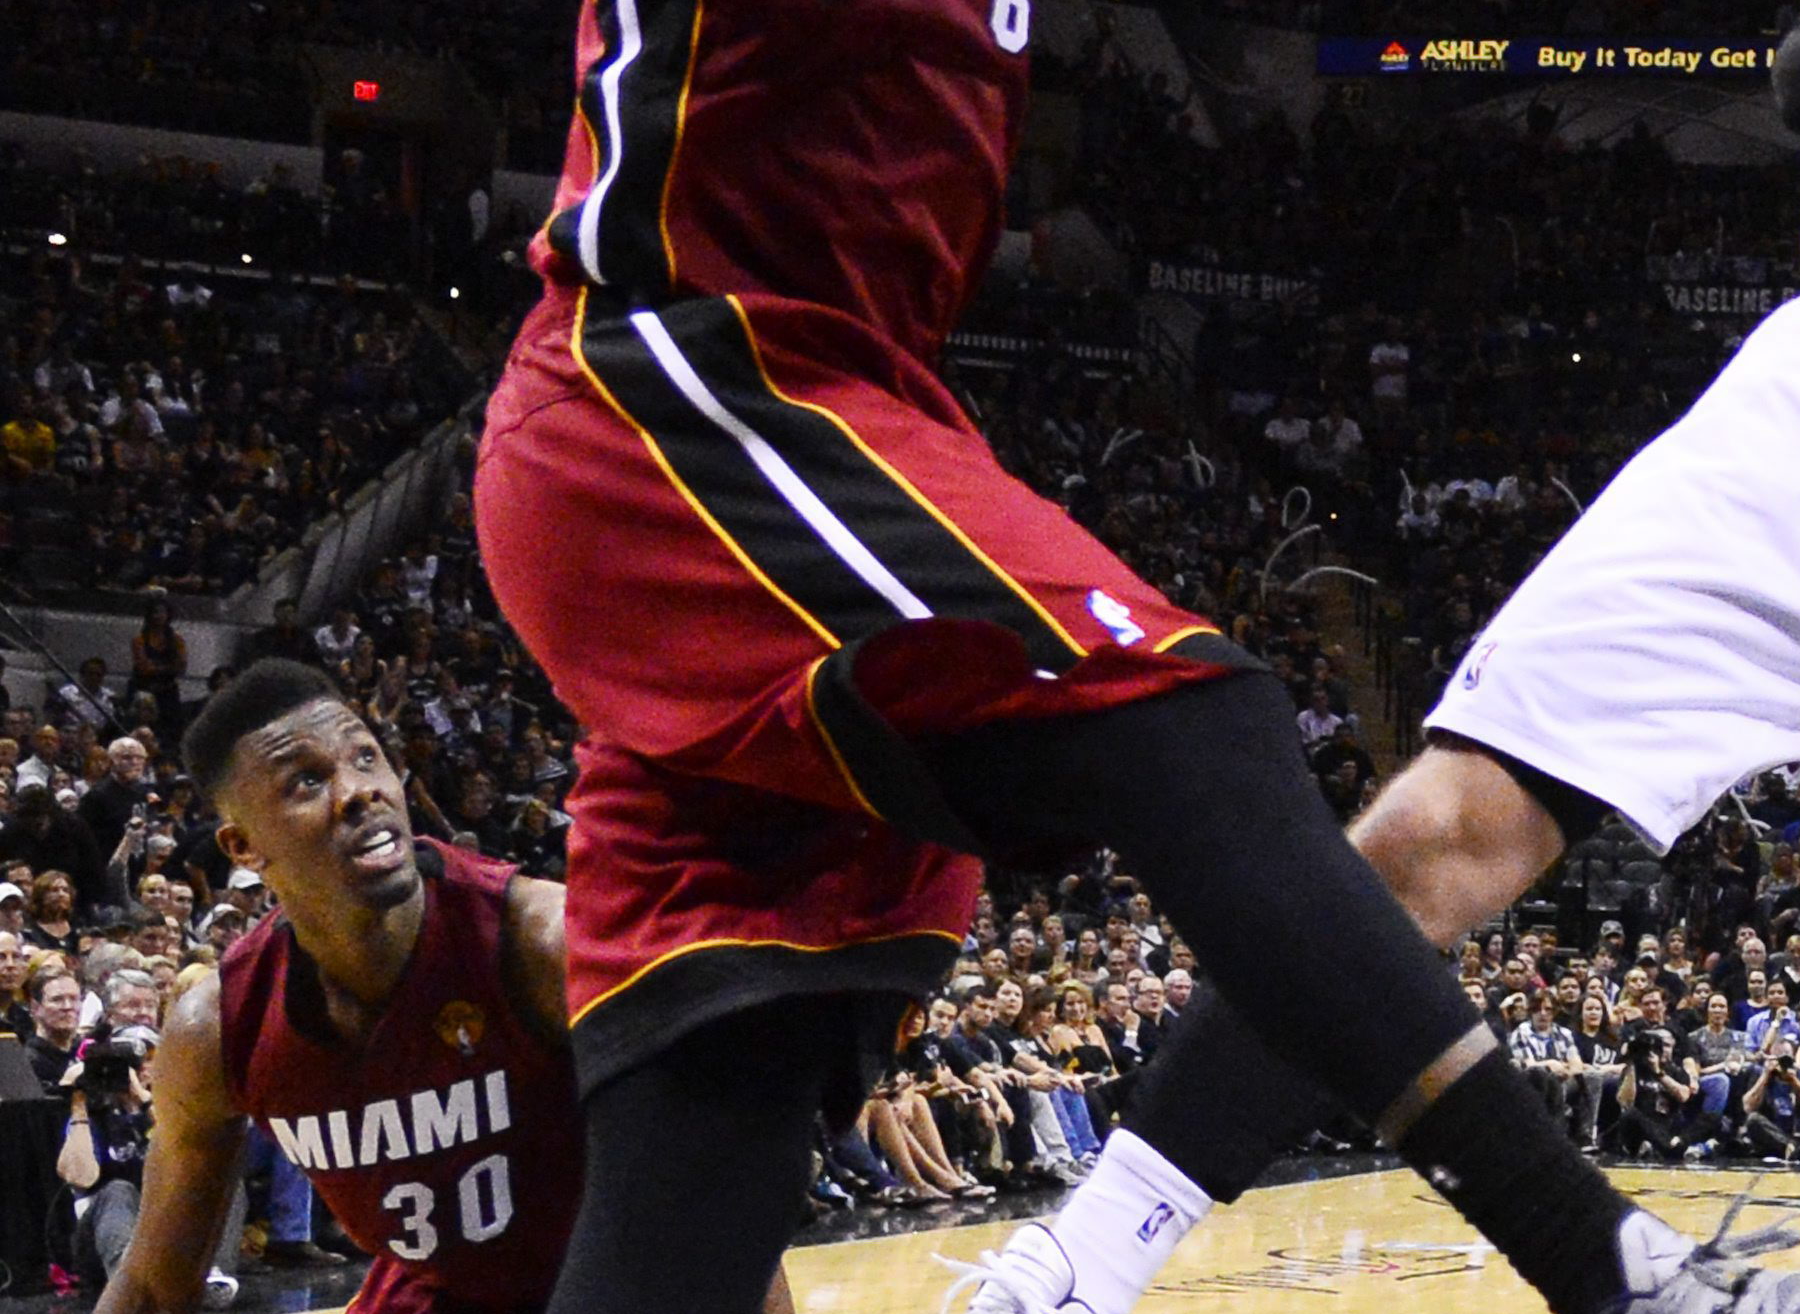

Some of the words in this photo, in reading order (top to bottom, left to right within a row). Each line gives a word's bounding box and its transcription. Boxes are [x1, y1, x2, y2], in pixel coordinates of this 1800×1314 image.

[1420, 40, 1510, 61] ASHLEY
[1538, 47, 1586, 73] Buy
[1596, 48, 1615, 67] It
[1623, 47, 1703, 73] Today
[1710, 47, 1757, 68] Get
[1149, 262, 1249, 298] BASELINE
[268, 1069, 511, 1170] MIAMI
[382, 1153, 514, 1261] 30
